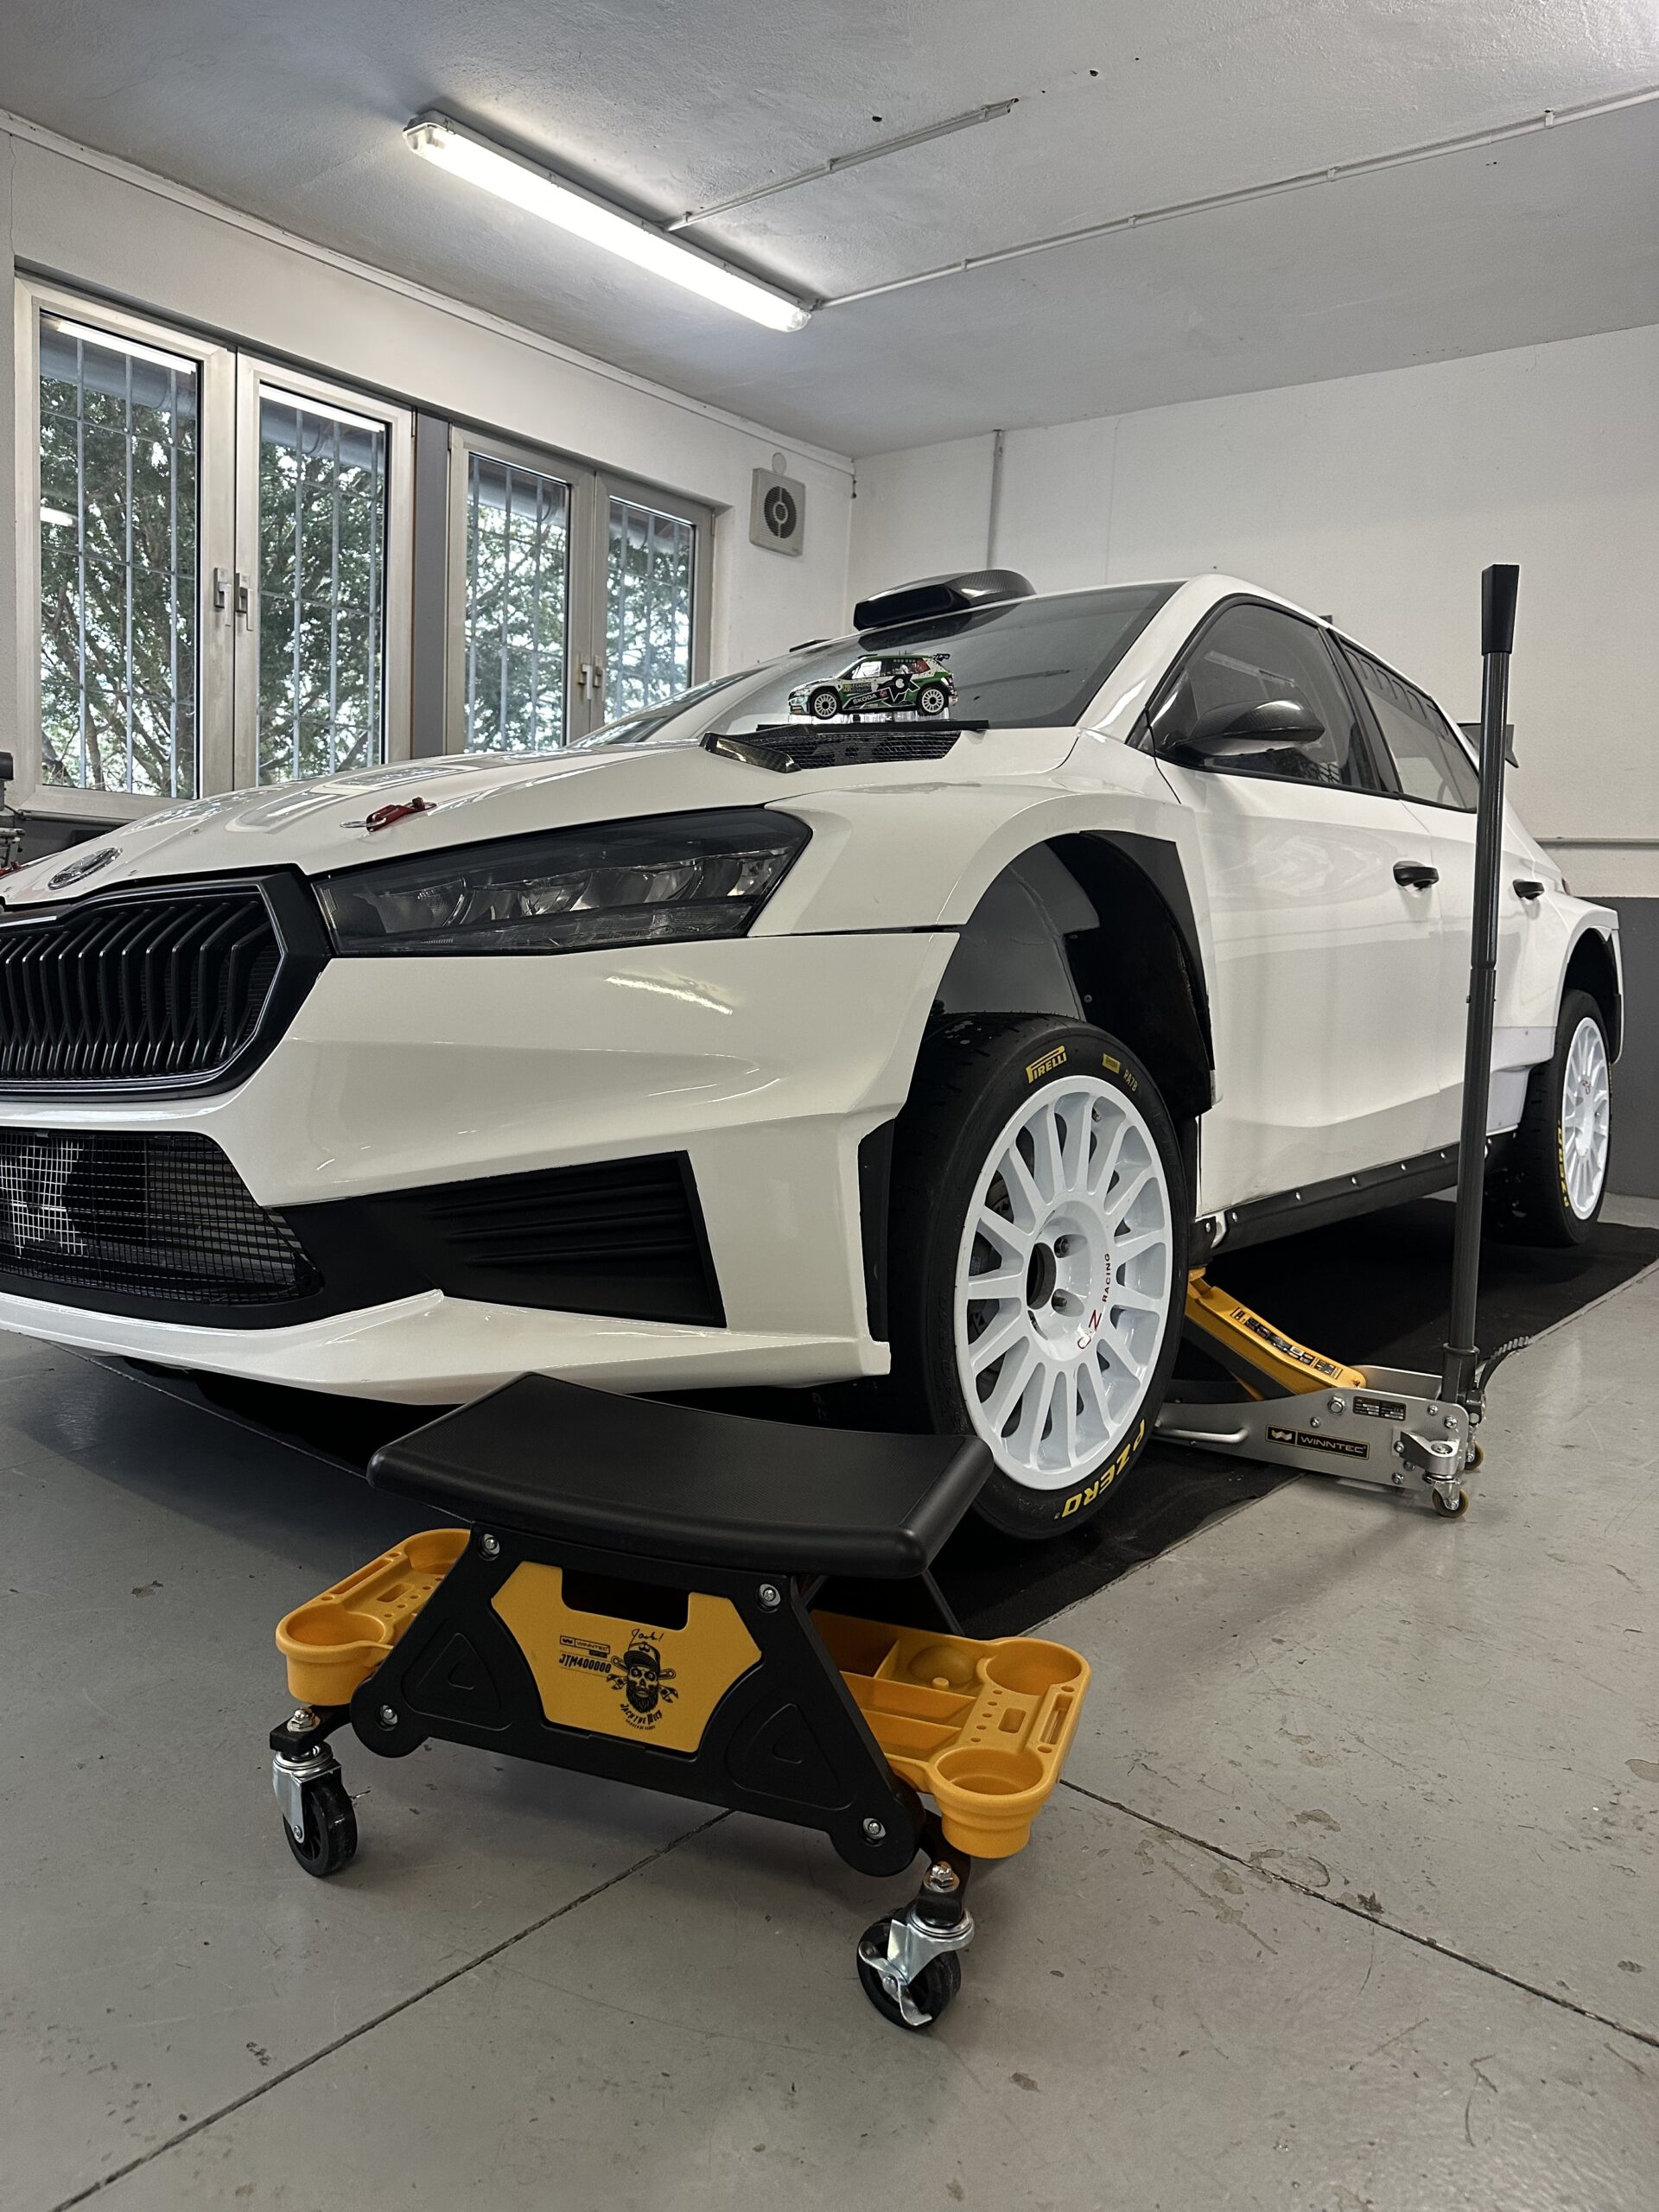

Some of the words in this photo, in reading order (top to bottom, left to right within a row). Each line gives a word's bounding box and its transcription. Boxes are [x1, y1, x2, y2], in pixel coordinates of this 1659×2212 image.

[1026, 1045, 1067, 1084] PIRELLI
[1102, 1253, 1111, 1303] RACING
[1133, 1419, 1146, 1452] P
[1300, 1435, 1365, 1454] WINNTEC
[1061, 1443, 1131, 1518] ZERO
[576, 1640, 609, 1651] WINNTEC
[559, 1654, 612, 1674] JTM400000
